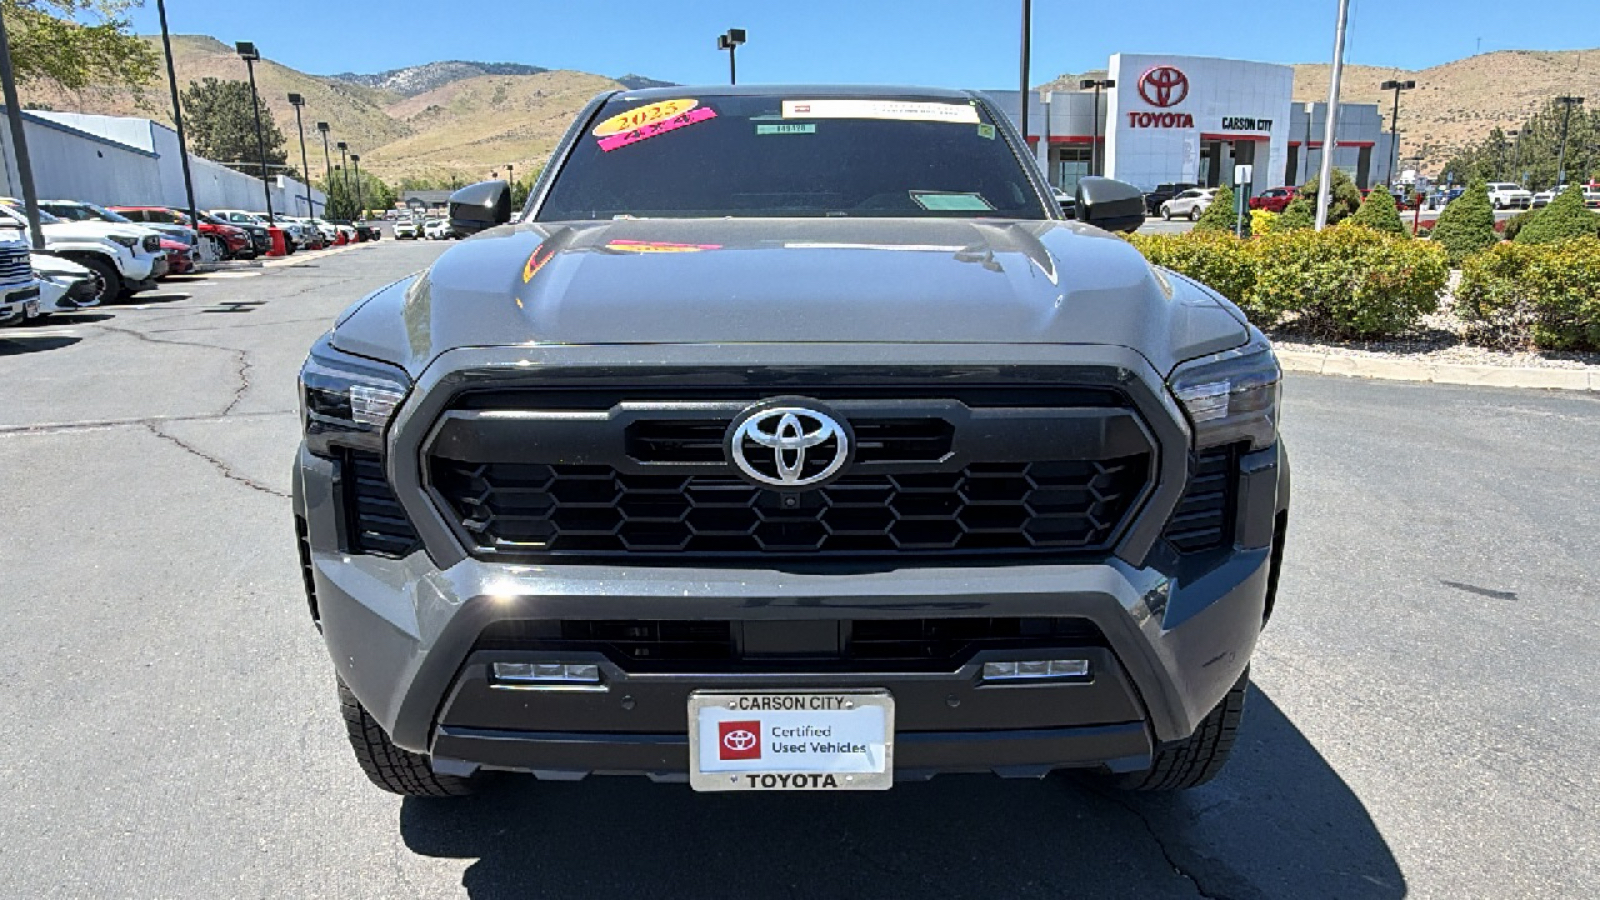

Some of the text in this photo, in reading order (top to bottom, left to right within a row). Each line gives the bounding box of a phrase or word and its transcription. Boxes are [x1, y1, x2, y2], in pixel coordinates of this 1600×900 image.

[618, 102, 679, 131] 2025
[1128, 111, 1195, 128] TOYOTA
[1222, 117, 1273, 131] CARSON CITY
[739, 697, 845, 710] CARSON CITY
[772, 726, 831, 737] Certified
[772, 742, 867, 753] Used Vehicles
[746, 774, 838, 788] TOYOTA
